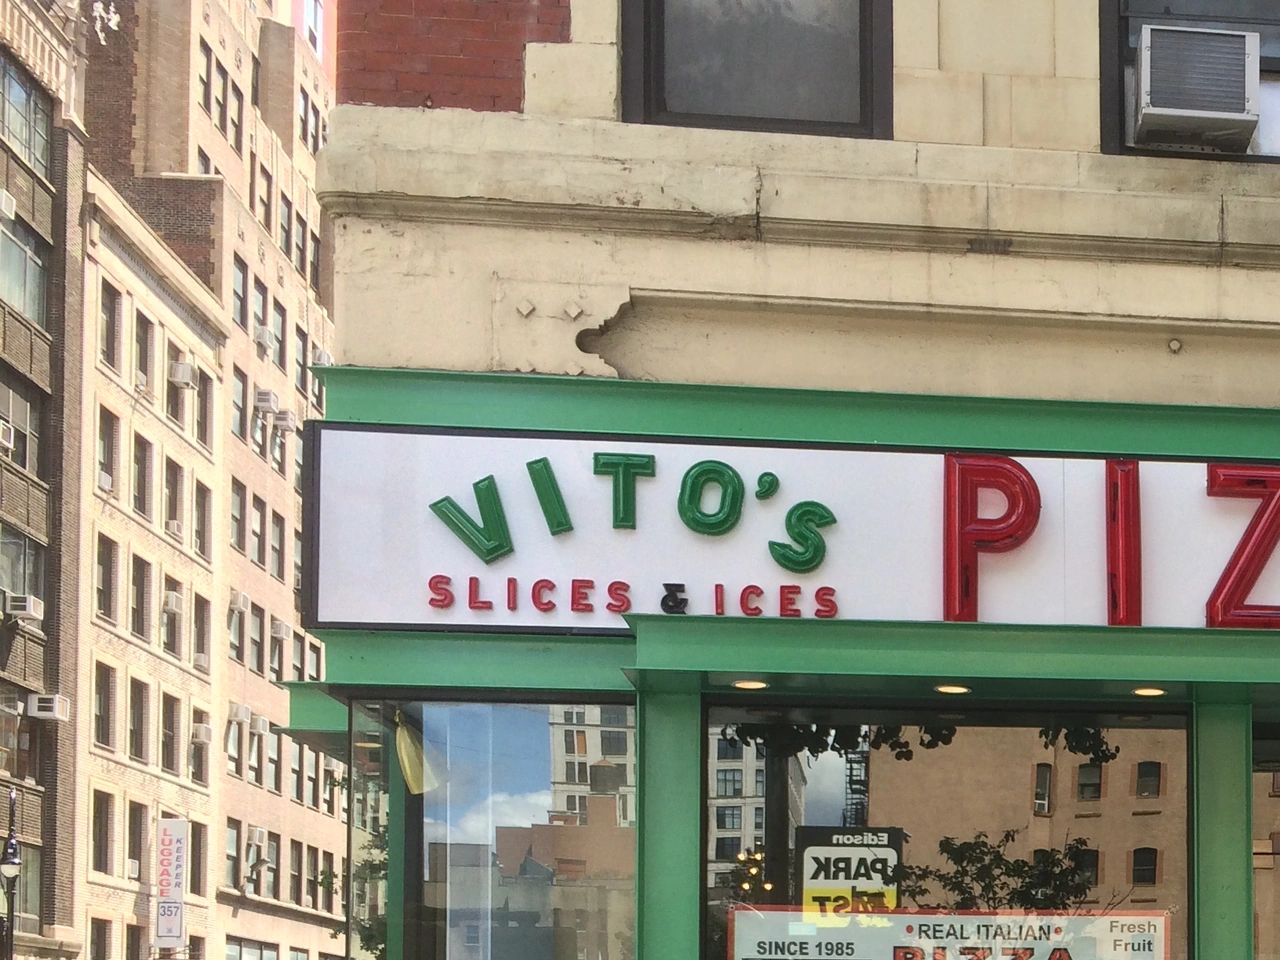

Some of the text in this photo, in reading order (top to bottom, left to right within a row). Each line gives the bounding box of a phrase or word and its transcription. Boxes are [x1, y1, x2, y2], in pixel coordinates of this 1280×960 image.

[428, 451, 838, 574] VITO'S
[428, 574, 839, 619] SLICES & ICES
[159, 828, 172, 897] LUGGAGE
[174, 837, 183, 889] KEEPER
[159, 905, 180, 917] 357
[918, 924, 1051, 941] REAL ITALIAN
[1109, 920, 1157, 933] Fresh
[756, 941, 855, 957] SINCE 1985
[1113, 939, 1153, 952] Fruit
